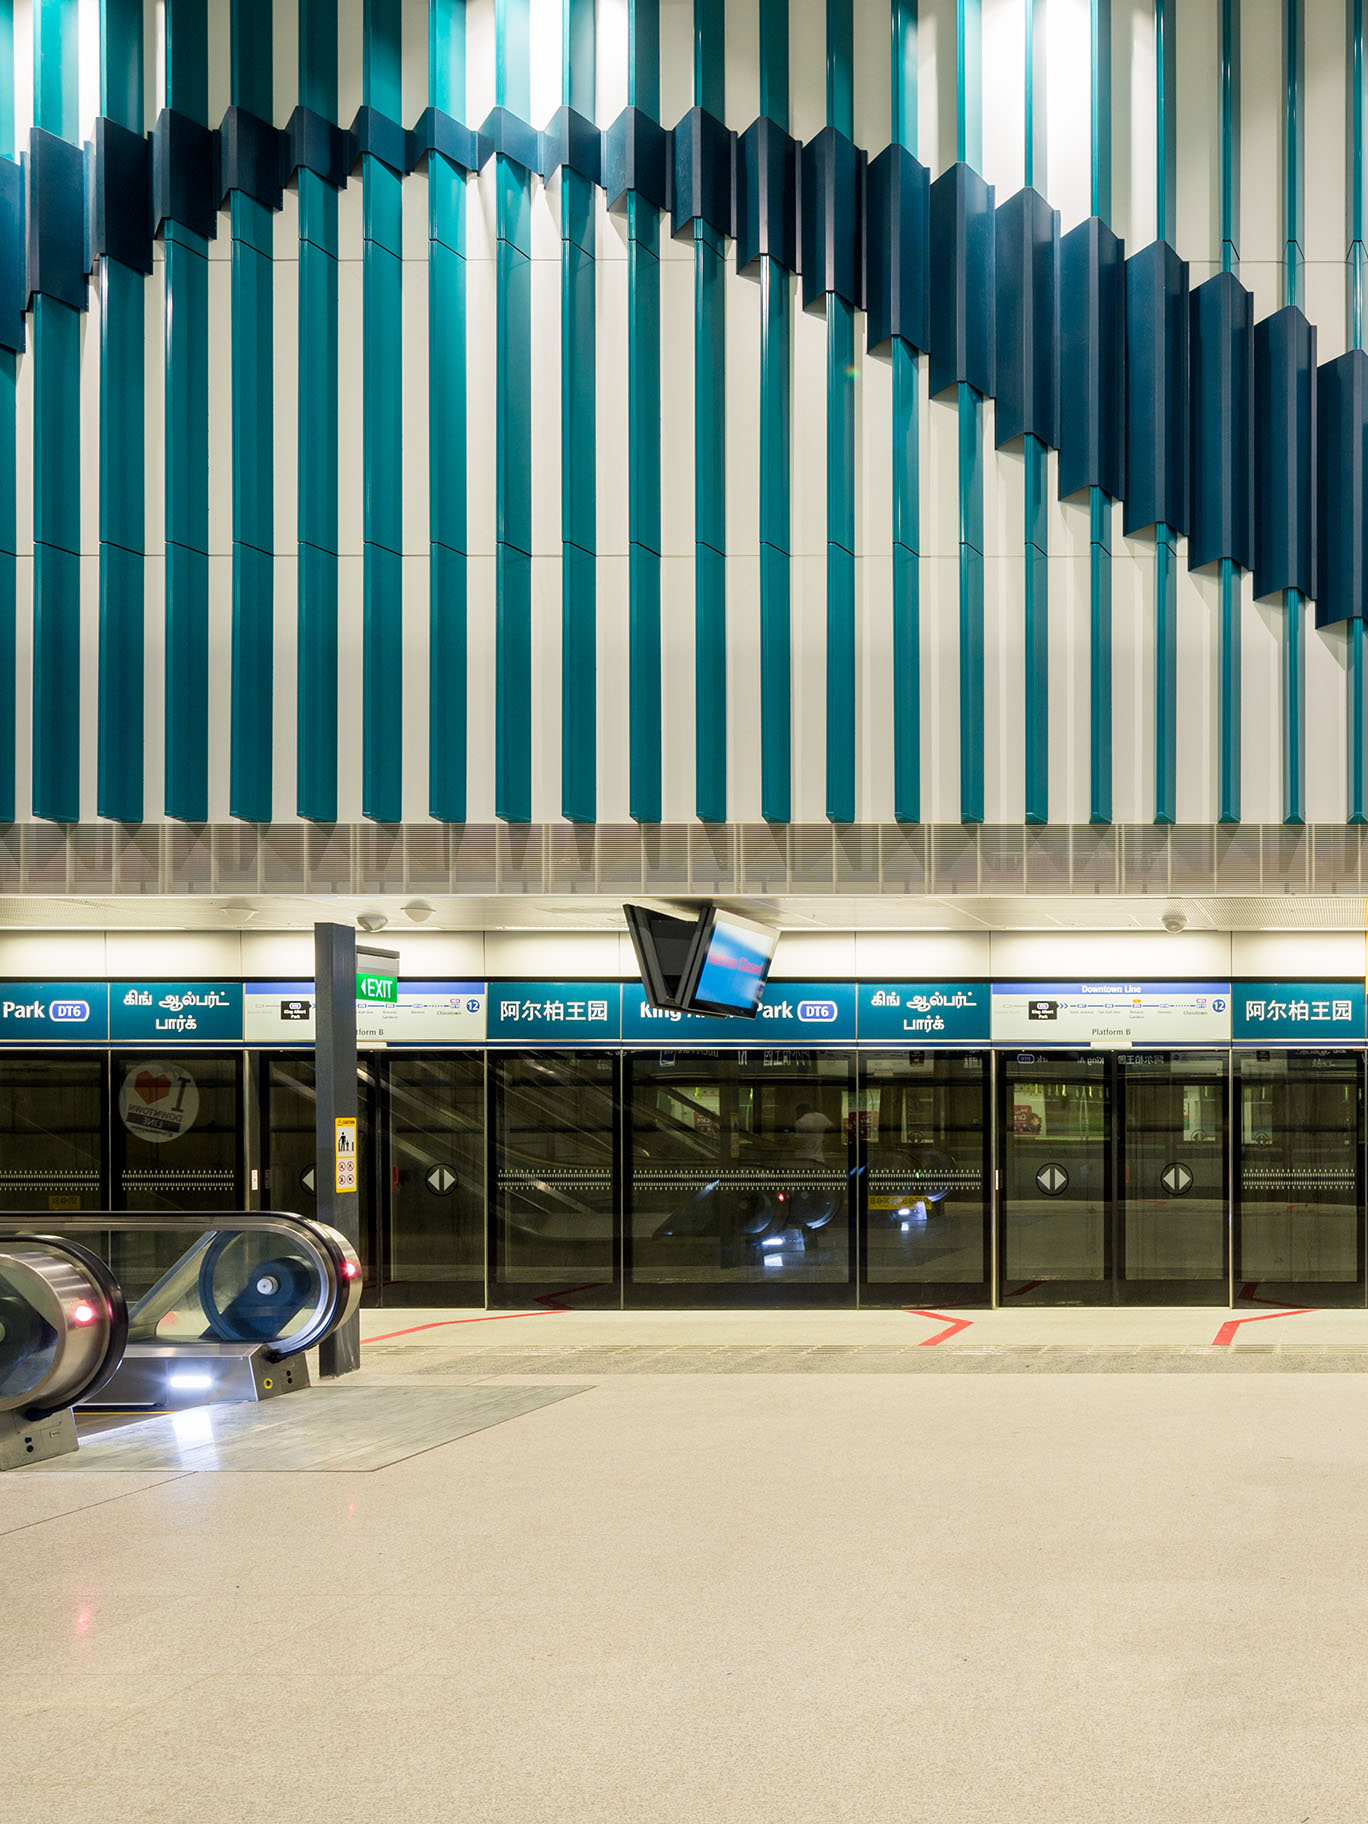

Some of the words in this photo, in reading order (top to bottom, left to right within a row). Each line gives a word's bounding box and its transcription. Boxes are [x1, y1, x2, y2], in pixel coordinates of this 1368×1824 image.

[367, 978, 393, 998] EXIT
[1082, 985, 1123, 993] Downtown
[1124, 985, 1142, 993] Line
[123, 989, 152, 1006] கிங்
[871, 990, 899, 1006] கிங்
[3, 1000, 46, 1018] Park
[57, 1004, 81, 1017] DT6
[500, 1000, 608, 1021] 阿尔柏王园
[806, 1005, 829, 1017] DT6
[1246, 1000, 1353, 1022] 阿尔柏王园
[155, 1014, 197, 1033] பார்க்
[356, 1028, 377, 1036] form
[379, 1028, 384, 1036] B
[903, 1015, 945, 1033] பார்க்
[1092, 1028, 1124, 1036] Platform
[1126, 1028, 1131, 1036] B
